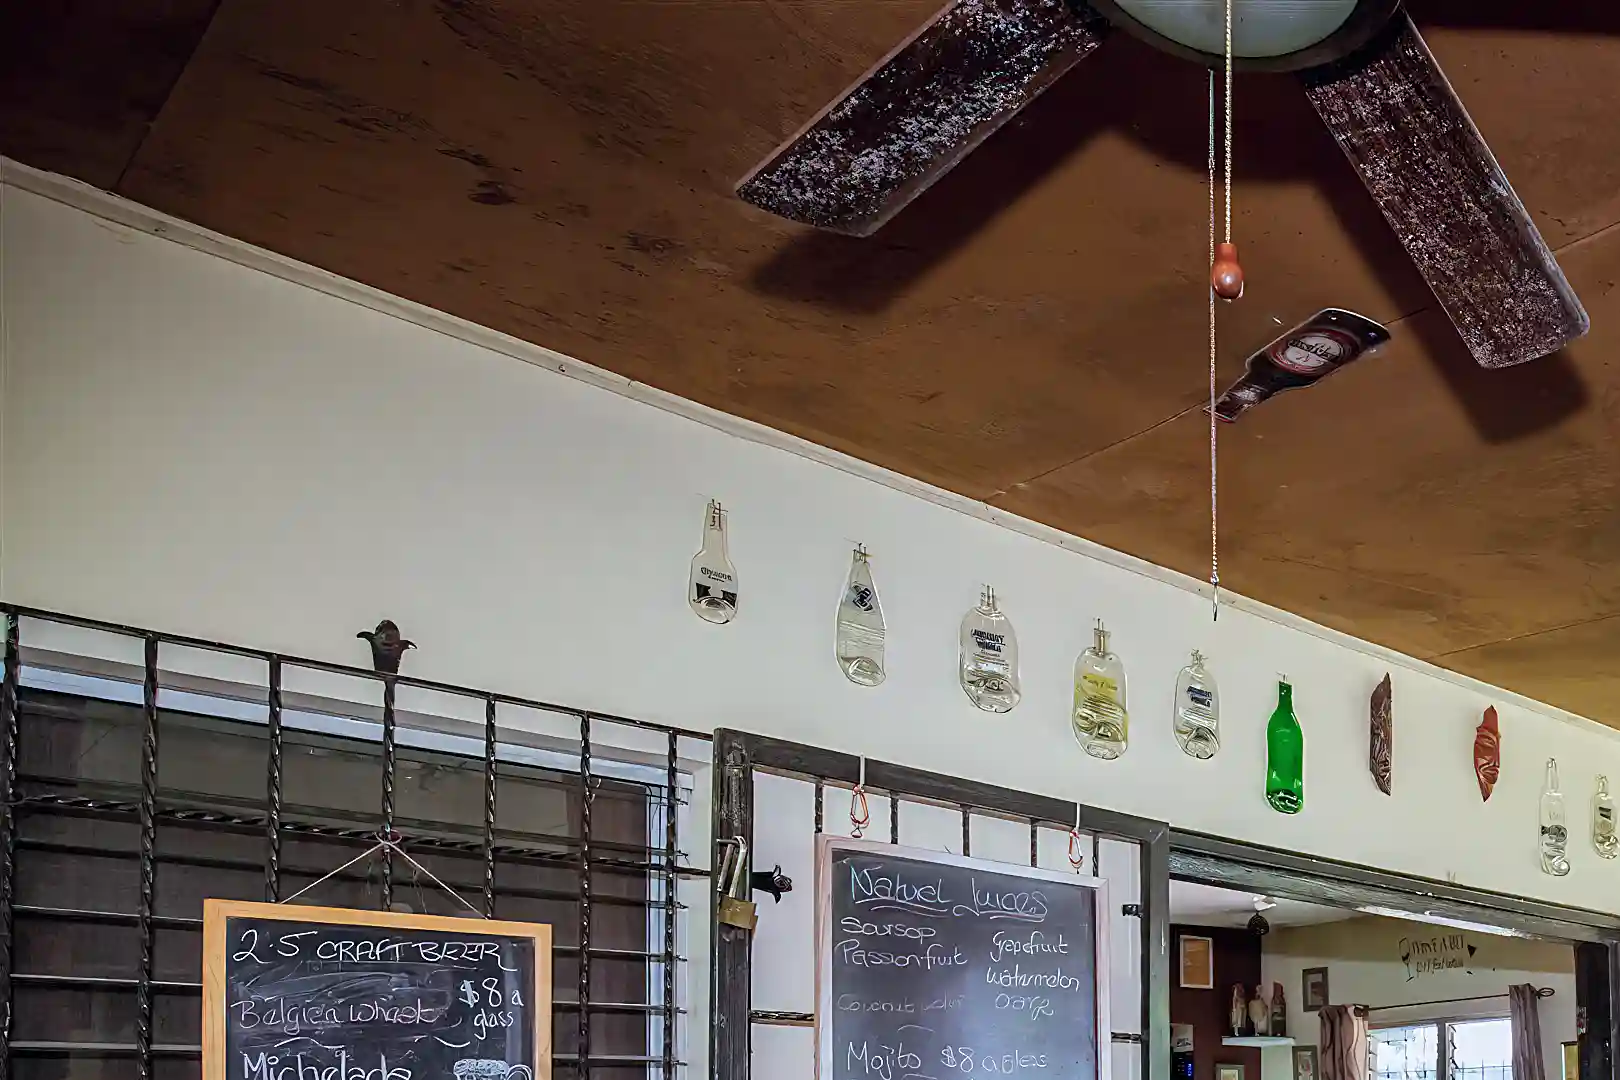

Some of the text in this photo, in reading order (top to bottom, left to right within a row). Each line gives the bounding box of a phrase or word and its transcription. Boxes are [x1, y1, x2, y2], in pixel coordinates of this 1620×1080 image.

[841, 917, 936, 944] Soursop
[316, 938, 411, 962] CRAFT
[411, 941, 518, 971] BEER
[459, 978, 524, 1008] $8 a
[473, 1009, 513, 1040] glass
[847, 1040, 921, 1080] Mojito
[941, 1046, 974, 1073] $8
[981, 1055, 998, 1072] a
